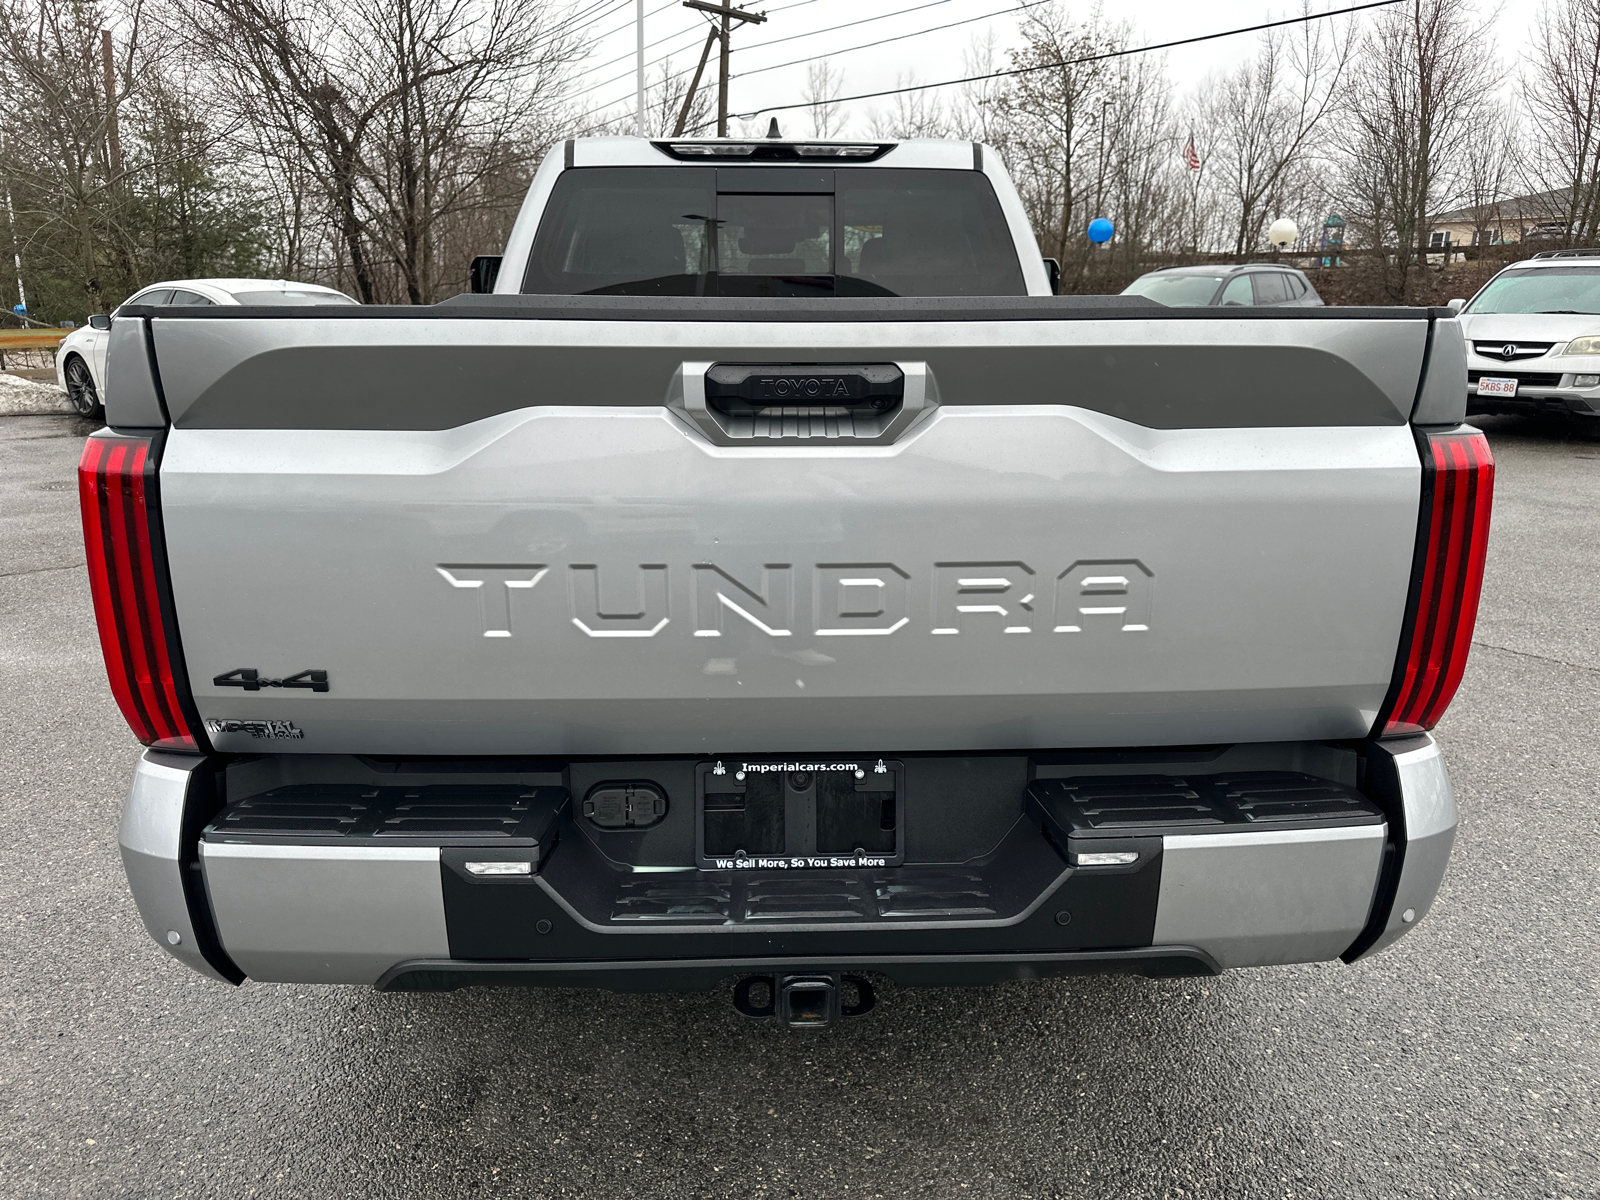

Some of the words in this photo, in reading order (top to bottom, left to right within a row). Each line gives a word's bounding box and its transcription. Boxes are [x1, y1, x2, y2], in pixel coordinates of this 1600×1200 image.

[760, 378, 849, 397] TOYOTA
[1480, 382, 1501, 392] 5KBS
[1503, 383, 1515, 393] 88
[435, 558, 1155, 638] TUNDRA
[204, 719, 302, 734] IMPERIAL
[742, 762, 858, 774] Imperialcars.com
[716, 859, 734, 869] We
[736, 859, 756, 868] Sell
[759, 858, 788, 870] More,
[791, 858, 805, 868] So
[808, 858, 828, 868] You
[830, 857, 856, 867] Save
[859, 857, 886, 867] More
